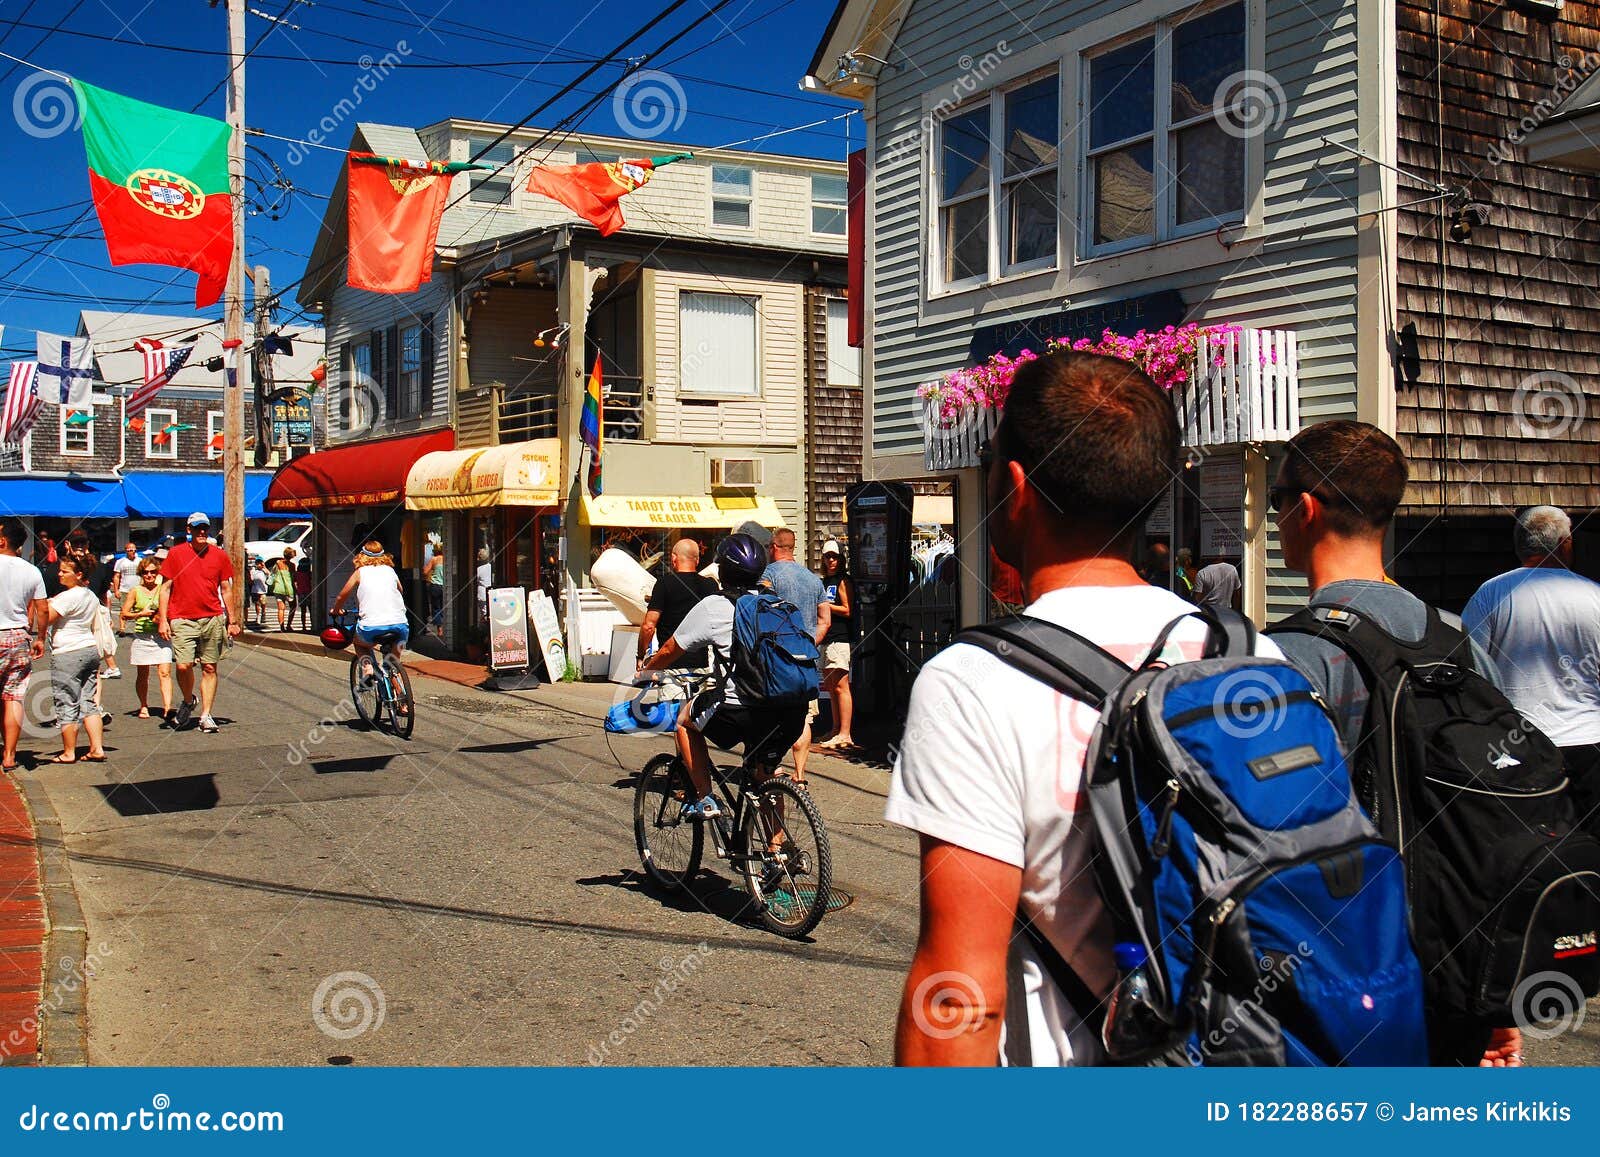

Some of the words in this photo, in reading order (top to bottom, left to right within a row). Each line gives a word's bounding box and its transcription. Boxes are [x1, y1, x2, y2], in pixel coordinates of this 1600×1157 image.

[521, 454, 549, 462] PSYCHIC
[425, 477, 450, 491] PSYCHIC
[475, 473, 499, 489] READER
[626, 500, 664, 512] TAROT
[669, 501, 701, 513] CARD
[649, 513, 697, 524] READER
